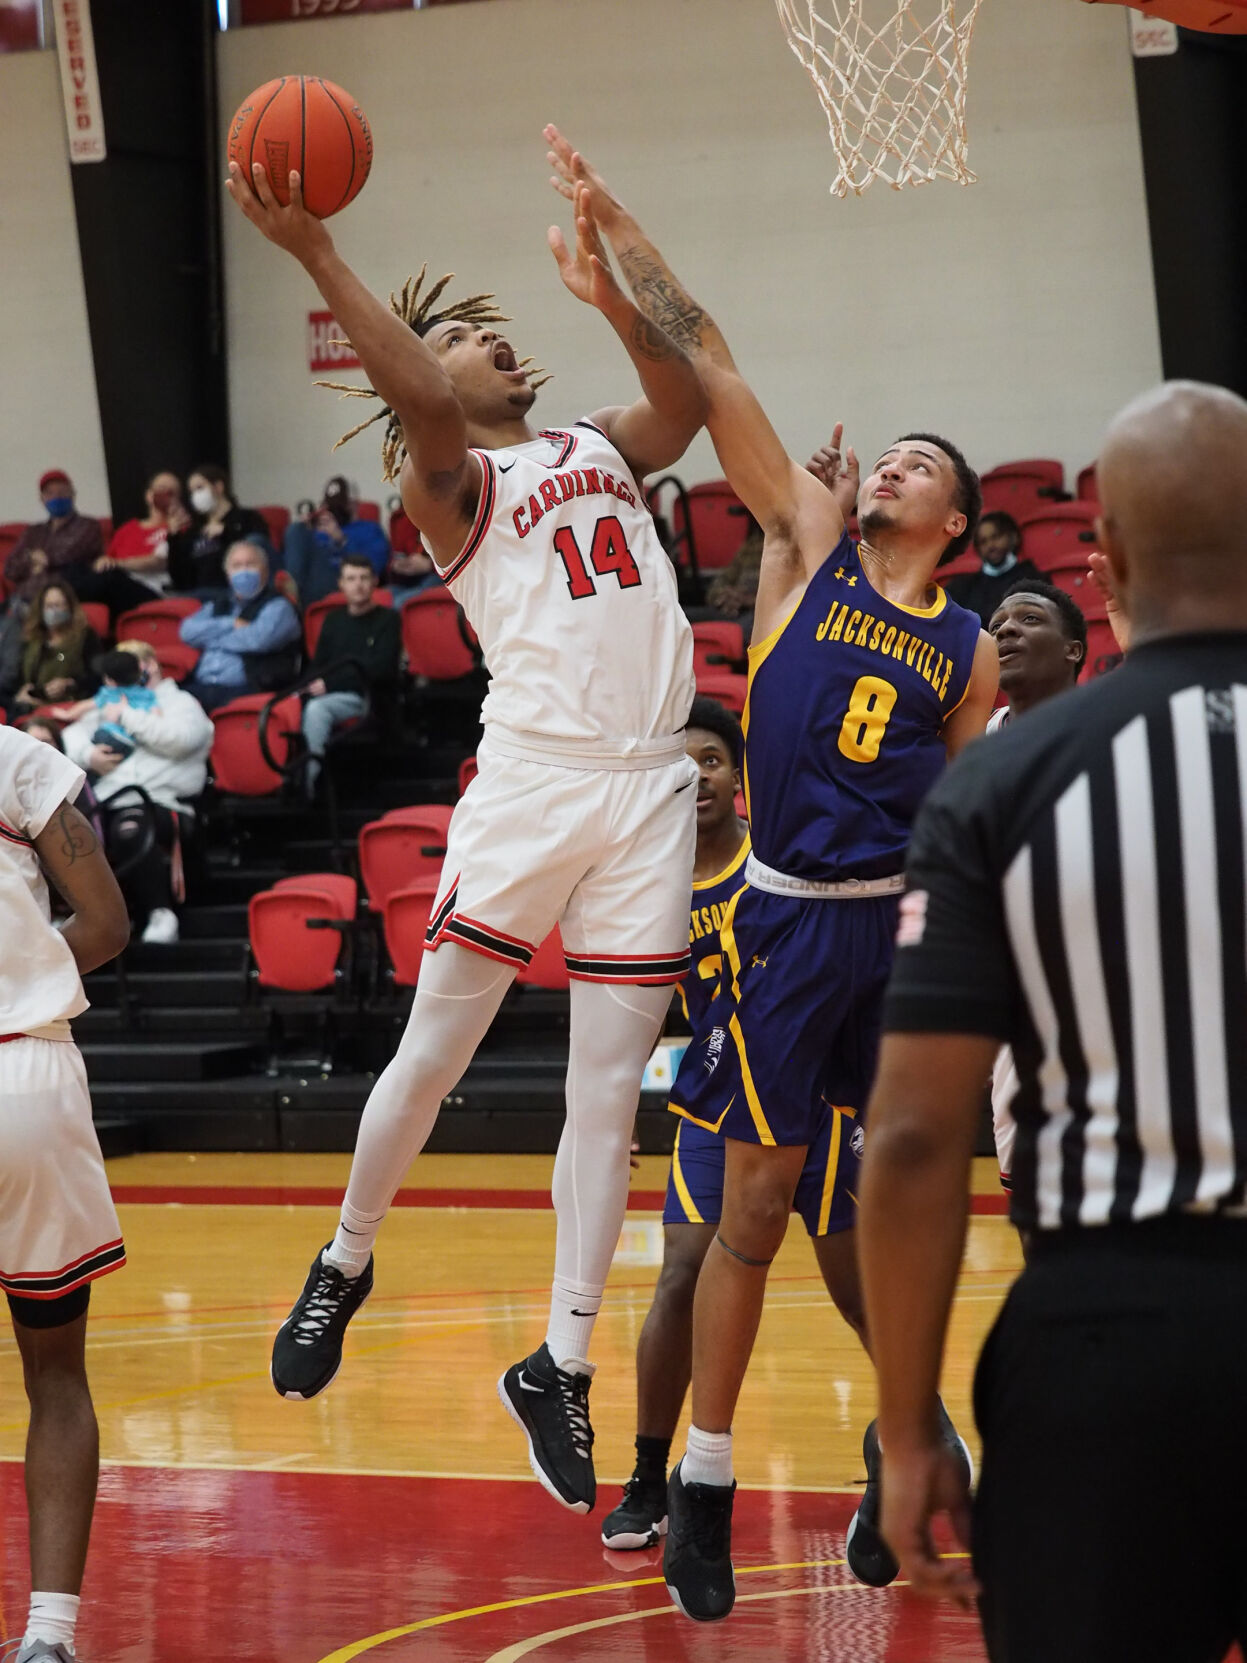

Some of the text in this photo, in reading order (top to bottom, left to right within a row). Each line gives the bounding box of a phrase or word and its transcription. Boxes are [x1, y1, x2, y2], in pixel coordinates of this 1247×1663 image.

[62, 0, 92, 131] ESERVED
[553, 516, 643, 600] 14
[815, 600, 954, 702] JACKSONVILLE
[837, 675, 898, 764] 8
